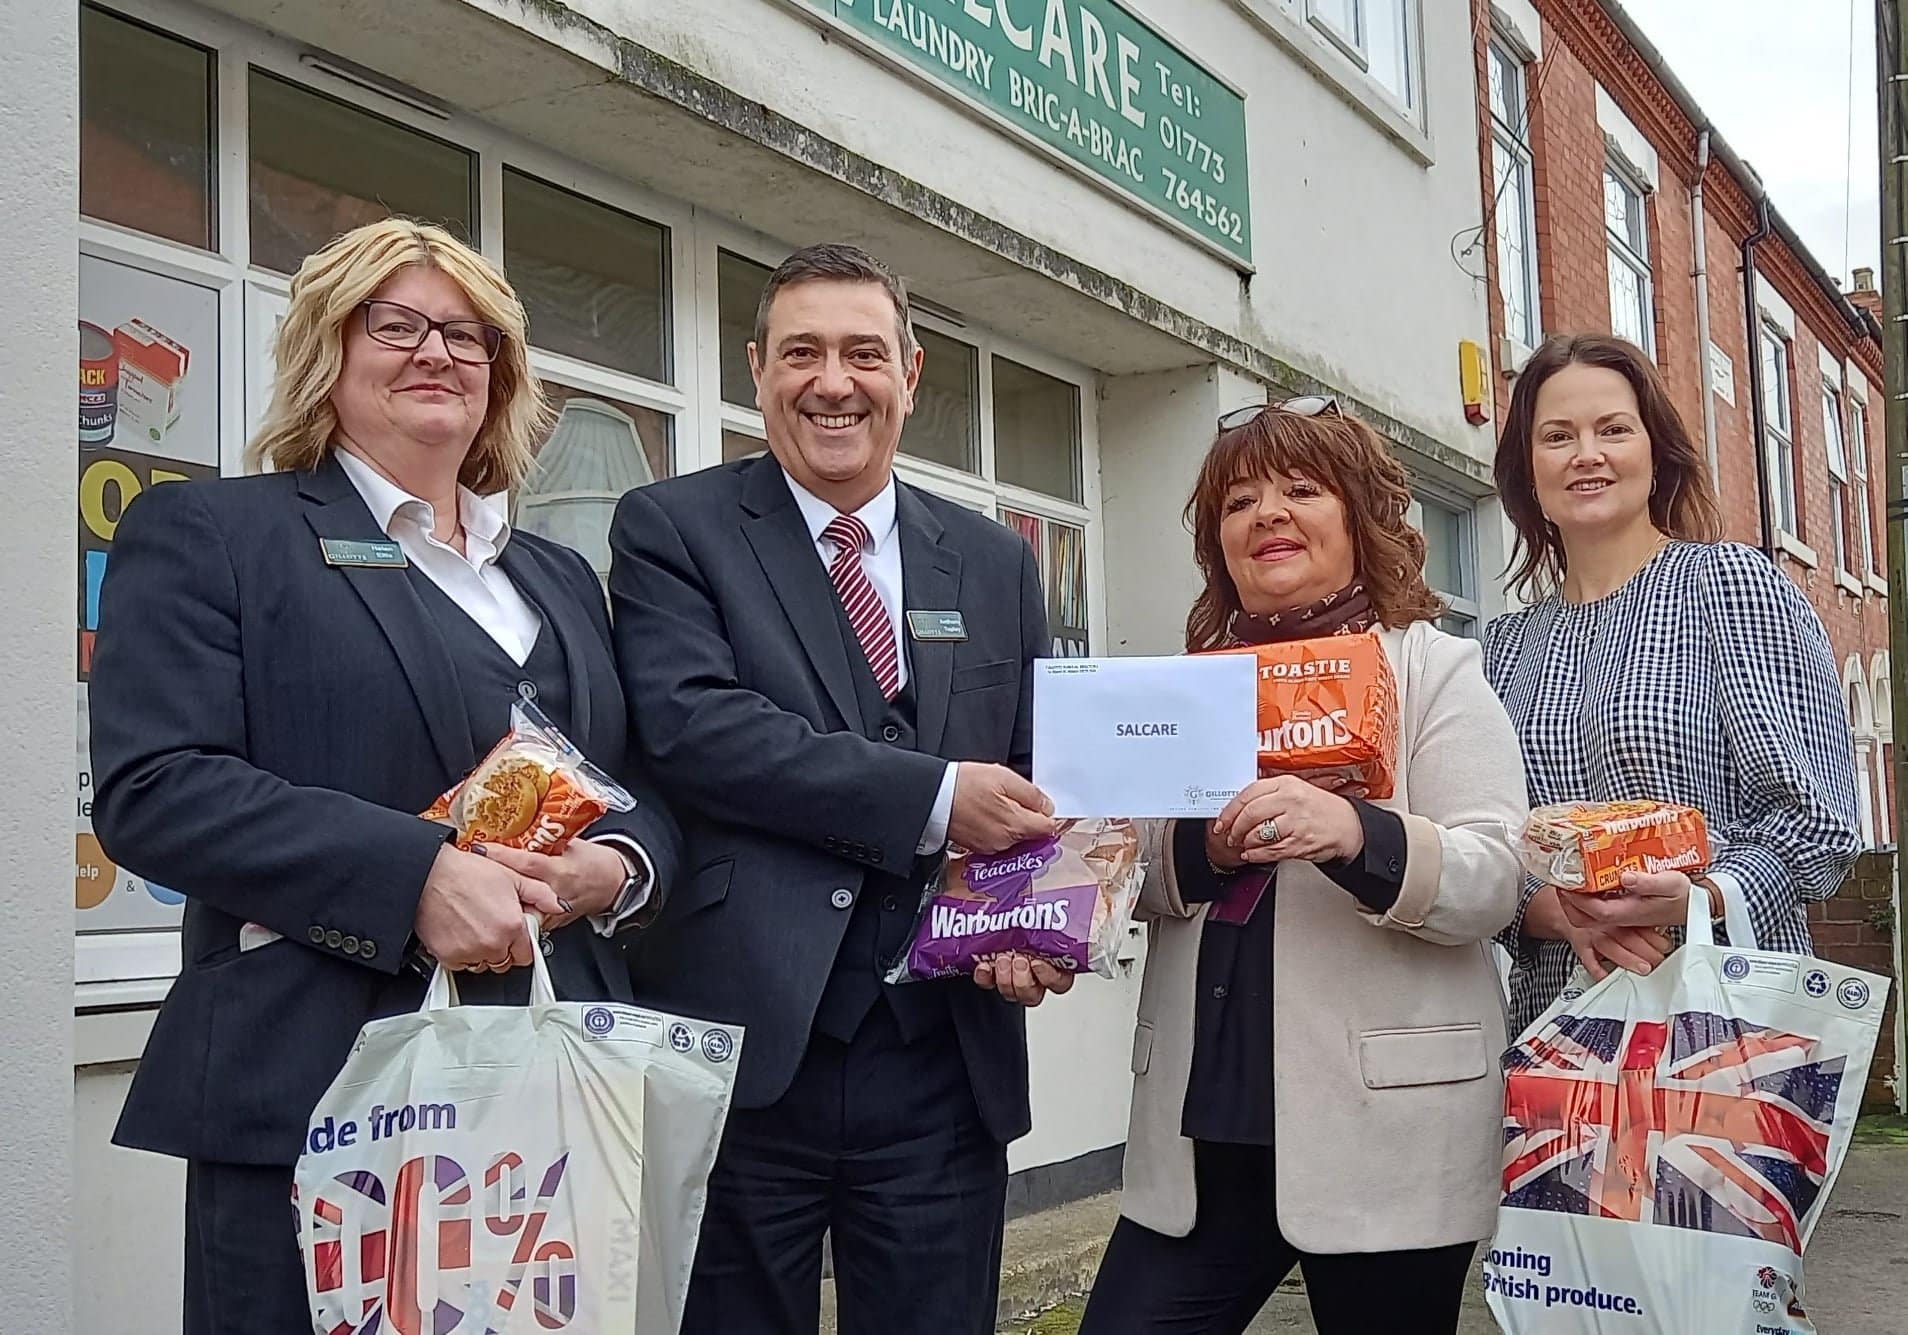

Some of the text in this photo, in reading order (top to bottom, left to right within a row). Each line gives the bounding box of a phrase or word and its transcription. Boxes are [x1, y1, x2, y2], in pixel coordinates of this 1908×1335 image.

[872, 0, 1145, 183] LAUNDRY BRIC-A-BRAC
[1155, 61, 1202, 118] Tel:
[1158, 116, 1226, 184] 01773
[1161, 167, 1244, 244] 764562
[1259, 659, 1351, 680] TOASTIE
[1116, 723, 1178, 737] SALCARE
[969, 852, 1044, 882] Teacakes
[1642, 845, 1700, 875] Warburtons
[126, 880, 135, 893] &
[931, 899, 1071, 940] Warburtons
[368, 1102, 457, 1142] from
[1482, 1272, 1643, 1316] British produce.
[1752, 1289, 1770, 1299] TEAM
